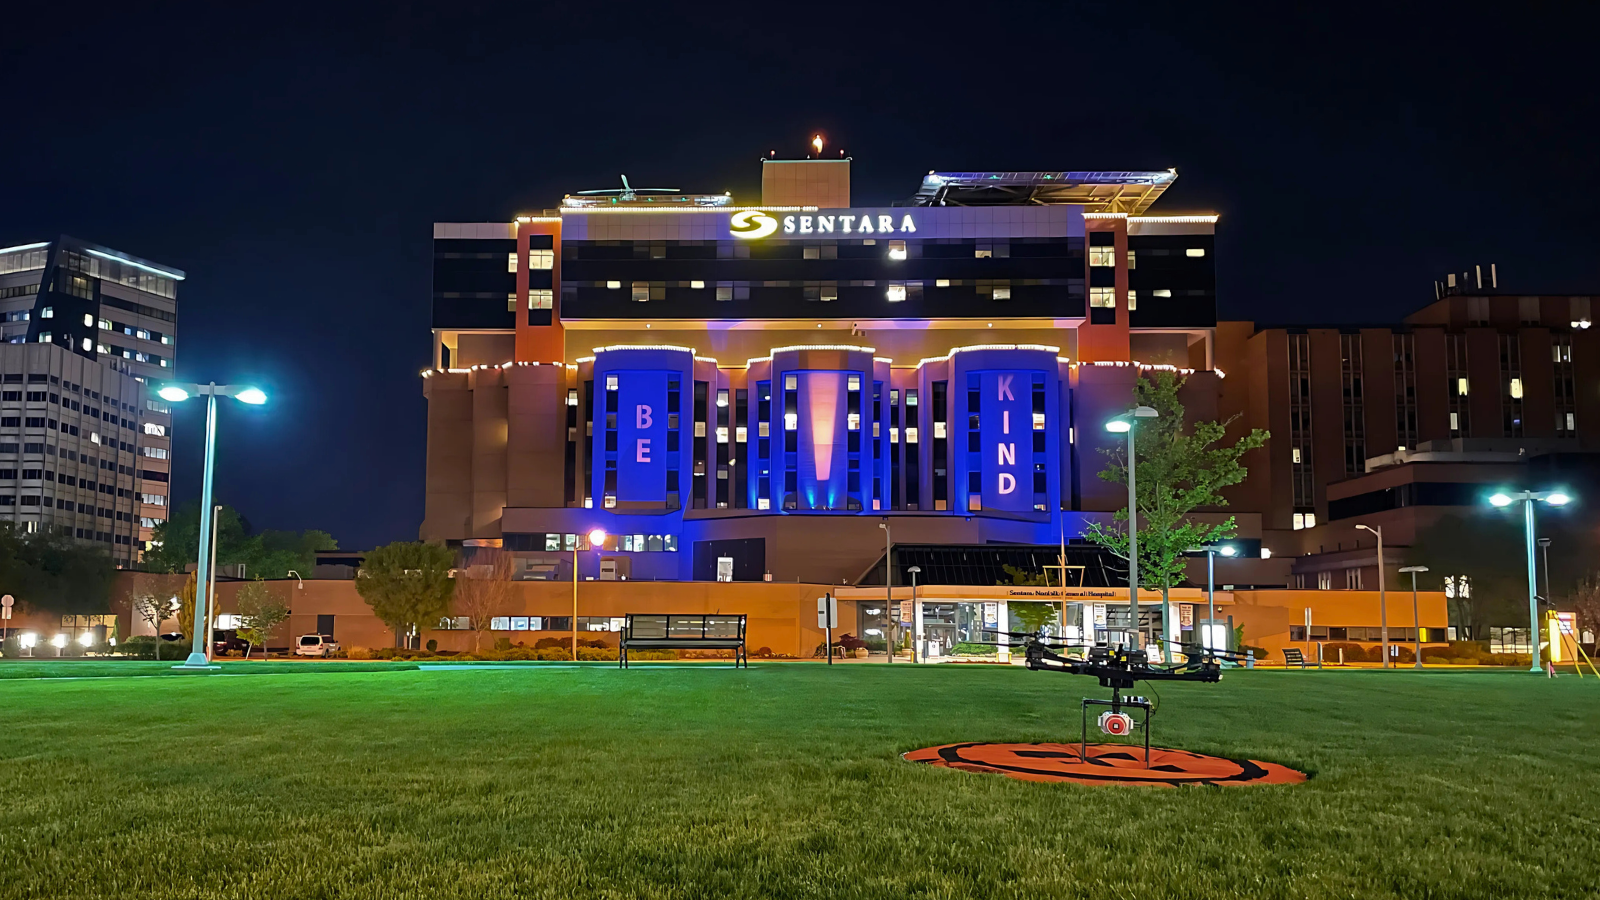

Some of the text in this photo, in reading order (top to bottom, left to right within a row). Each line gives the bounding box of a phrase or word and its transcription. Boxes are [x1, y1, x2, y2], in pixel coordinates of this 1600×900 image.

[784, 214, 916, 234] SENTARA
[636, 404, 653, 463] BE
[998, 375, 1016, 494] KIND
